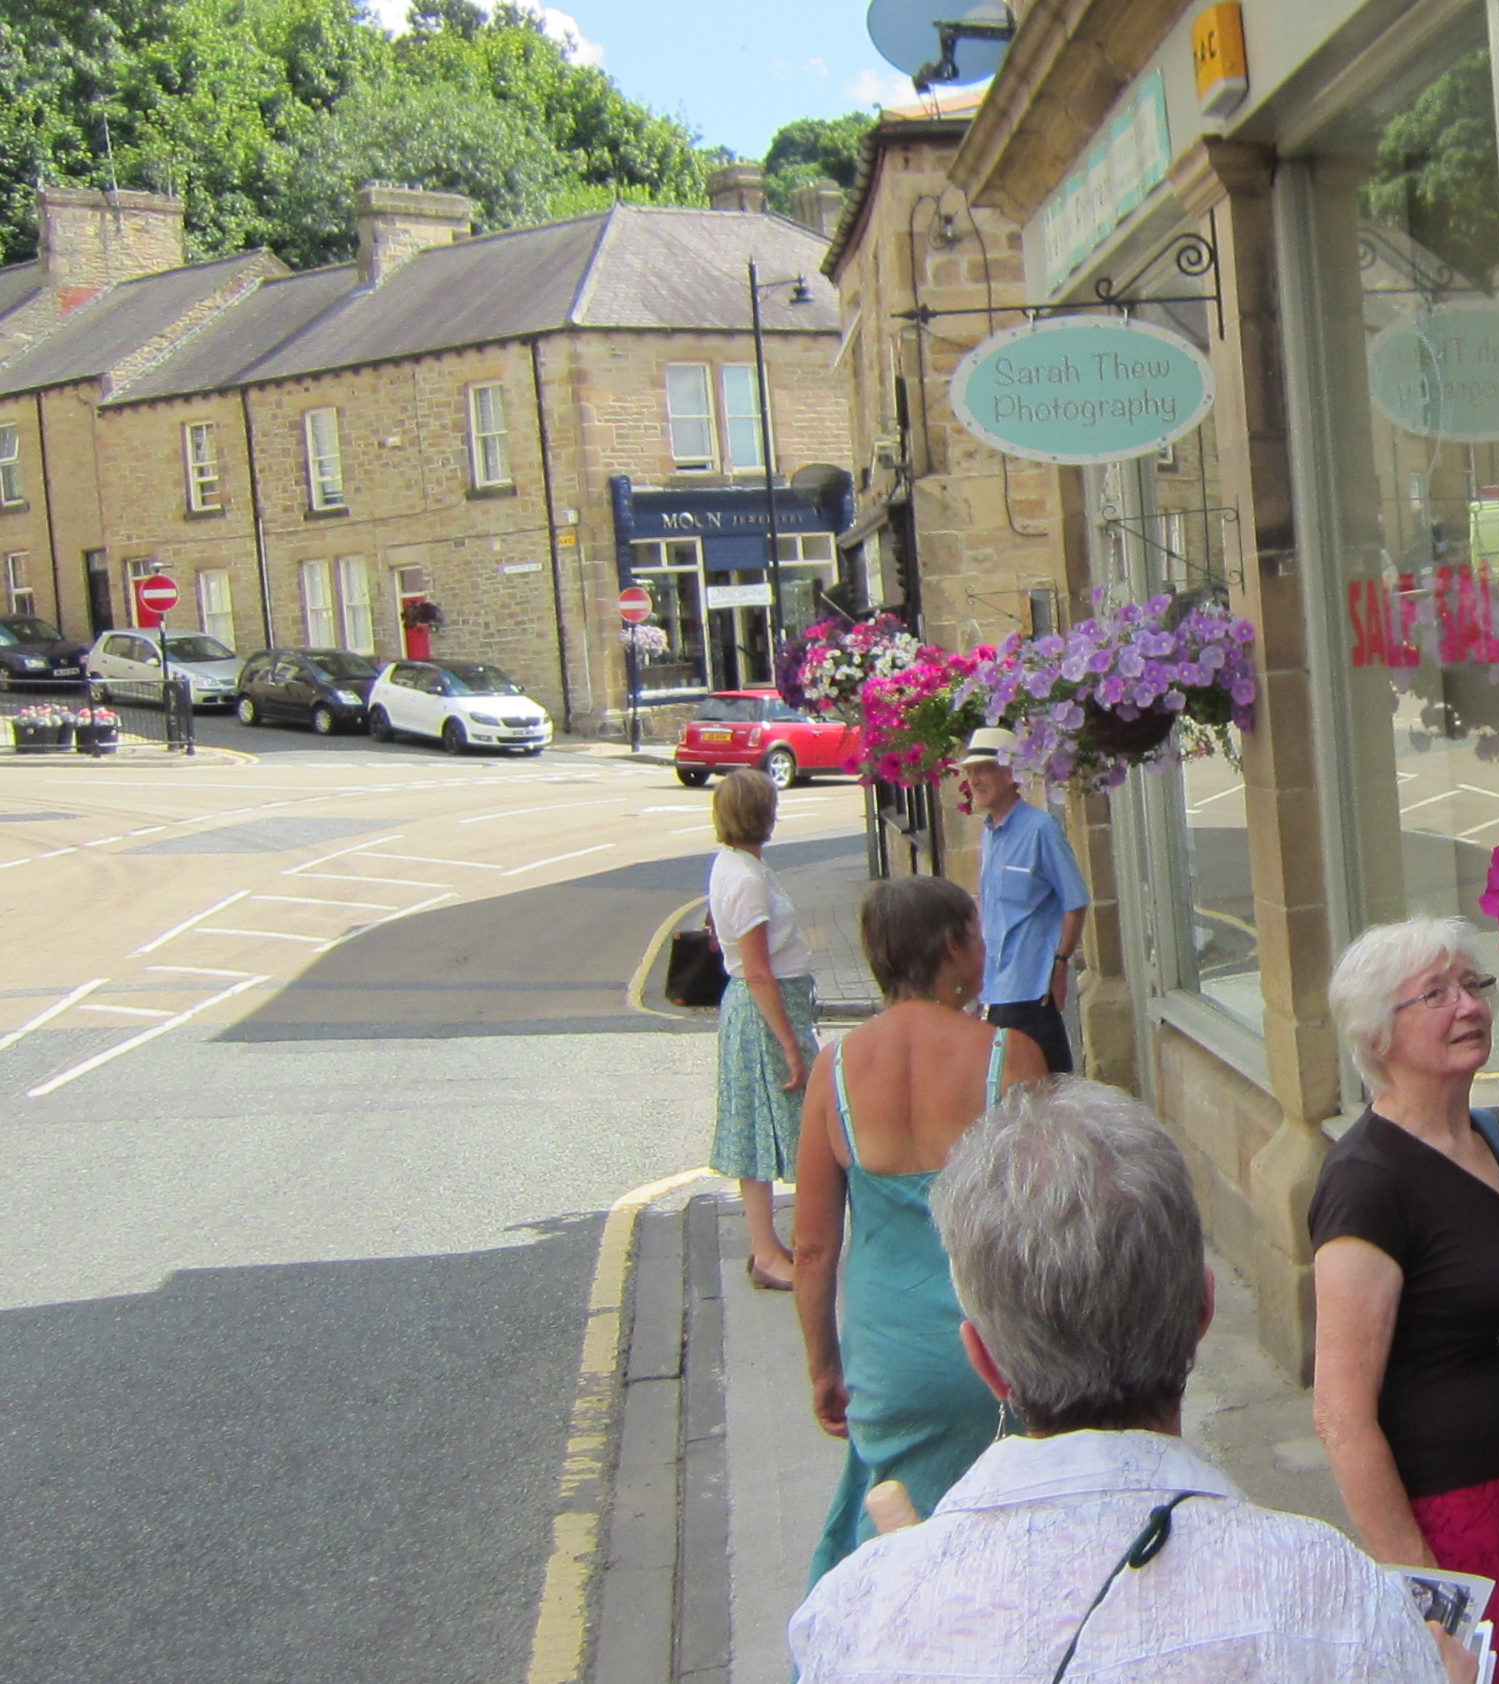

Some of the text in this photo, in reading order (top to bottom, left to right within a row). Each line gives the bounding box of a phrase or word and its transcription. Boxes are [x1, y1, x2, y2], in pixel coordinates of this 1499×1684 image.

[994, 351, 1172, 387] Sarah Thew
[993, 388, 1177, 427] Photography
[732, 513, 803, 526] JEWELERY
[1347, 572, 1421, 668] SALE
